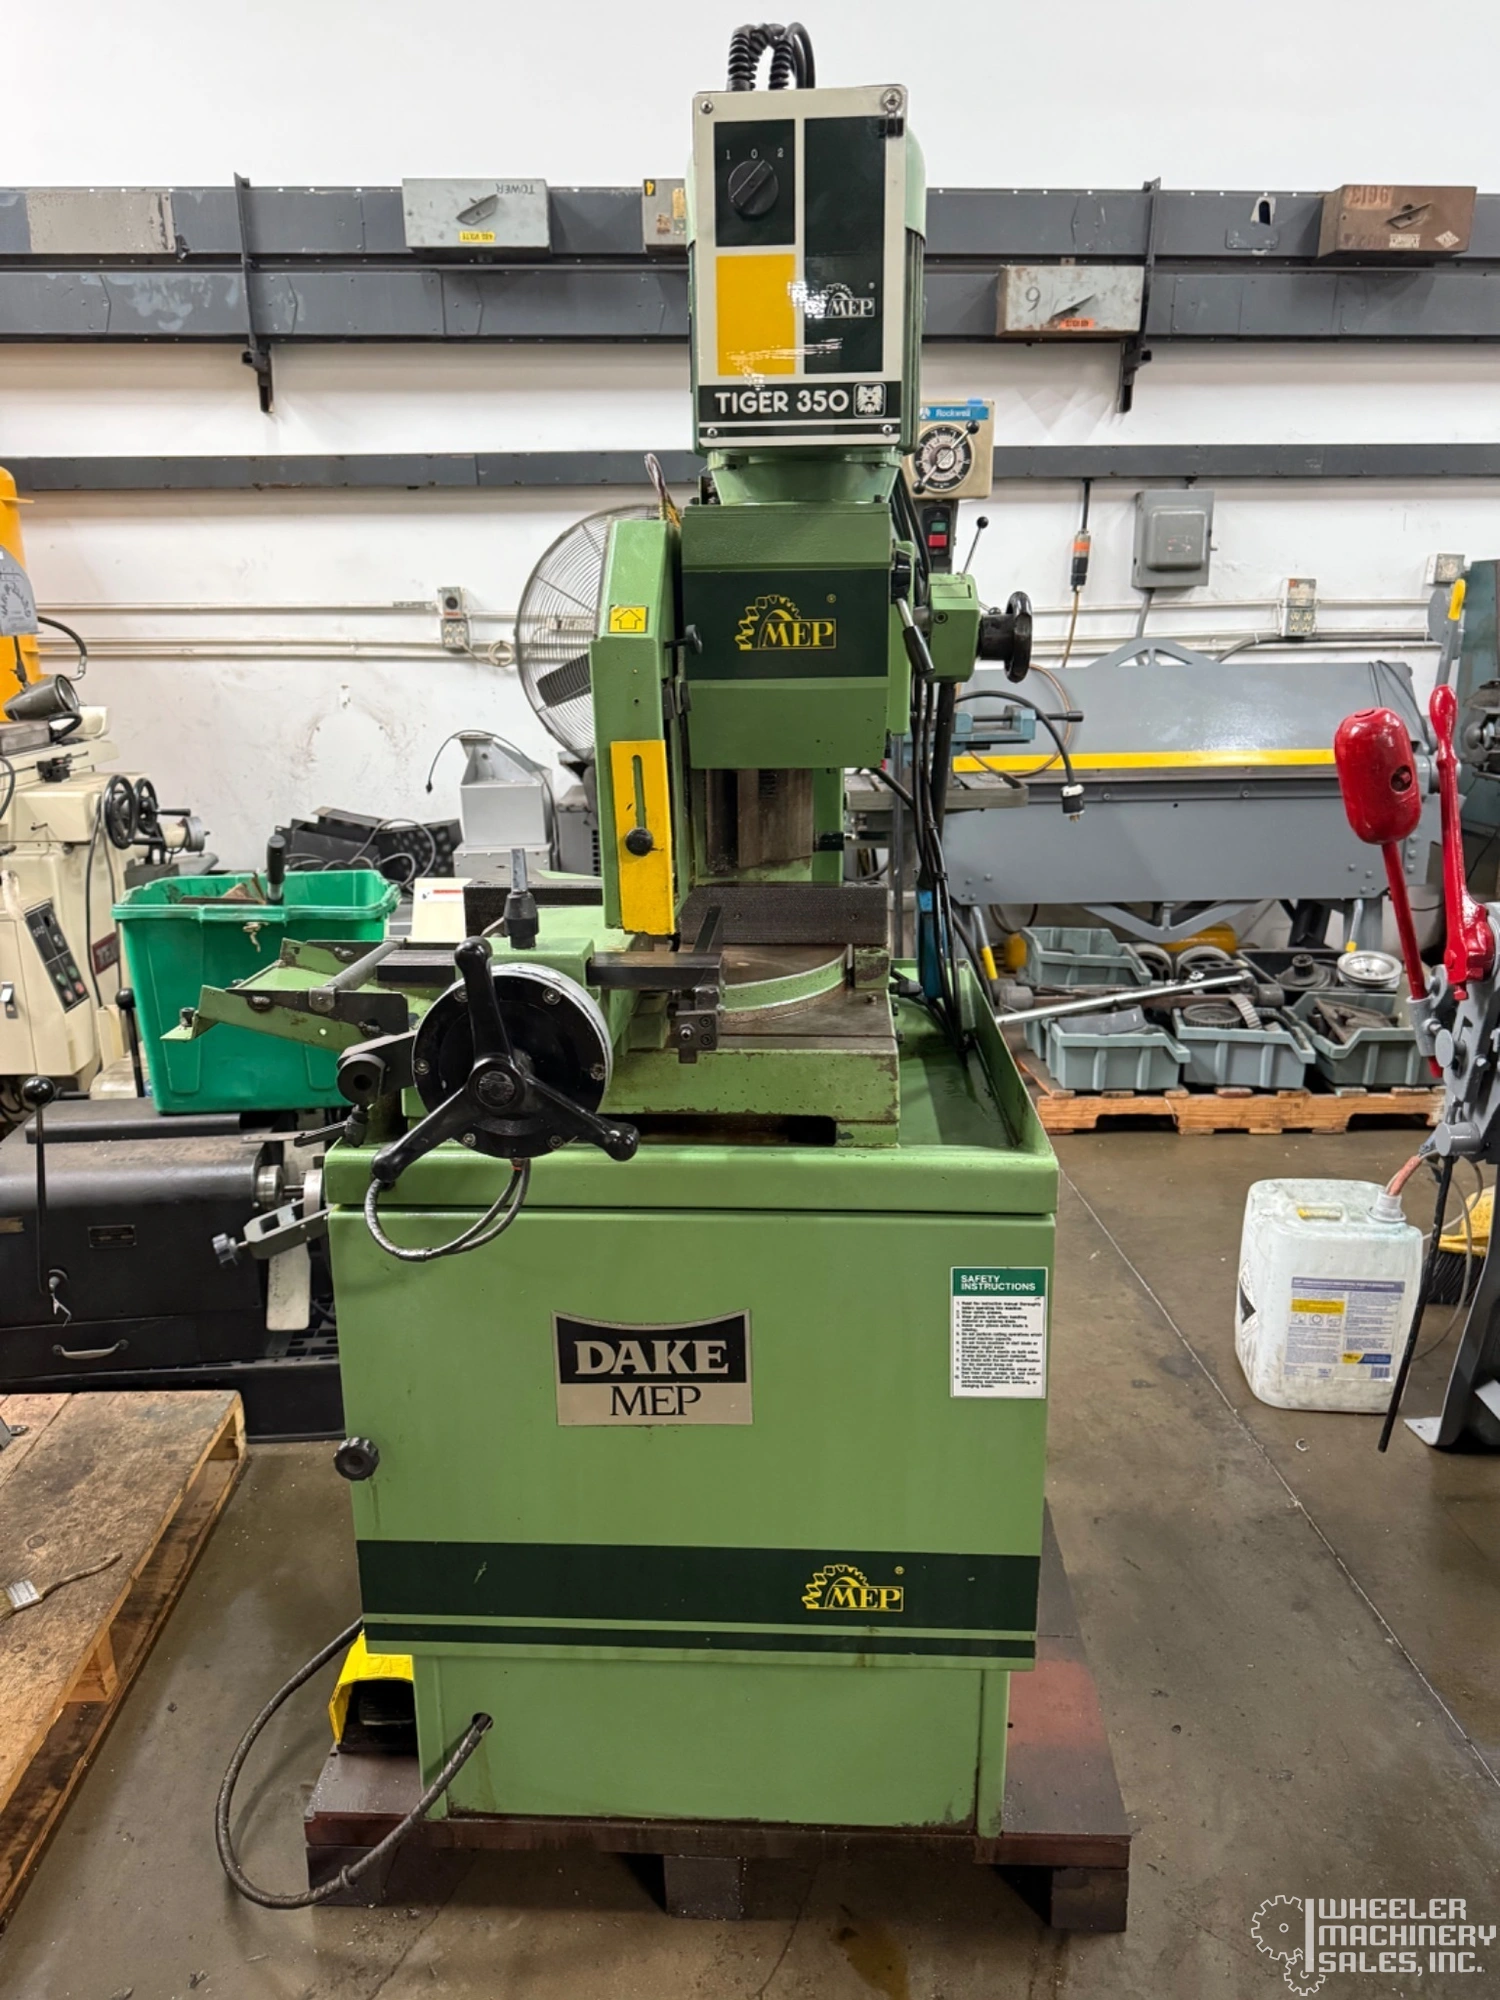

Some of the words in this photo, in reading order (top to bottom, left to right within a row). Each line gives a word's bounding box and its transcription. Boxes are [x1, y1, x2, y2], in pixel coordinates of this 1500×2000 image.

[725, 149, 731, 160] 1
[751, 149, 759, 159] 0
[777, 148, 785, 158] 2
[496, 183, 536, 195] TOWER
[827, 299, 875, 317] MEP
[715, 390, 788, 414] TIGER
[797, 388, 850, 413] 350
[762, 621, 834, 648] MEP
[961, 1275, 1001, 1283] SAFETY
[961, 1283, 1036, 1291] INSTRUCTIONS
[573, 1340, 729, 1375] DAKE
[609, 1385, 702, 1416] MEP
[829, 1587, 901, 1609] MEP
